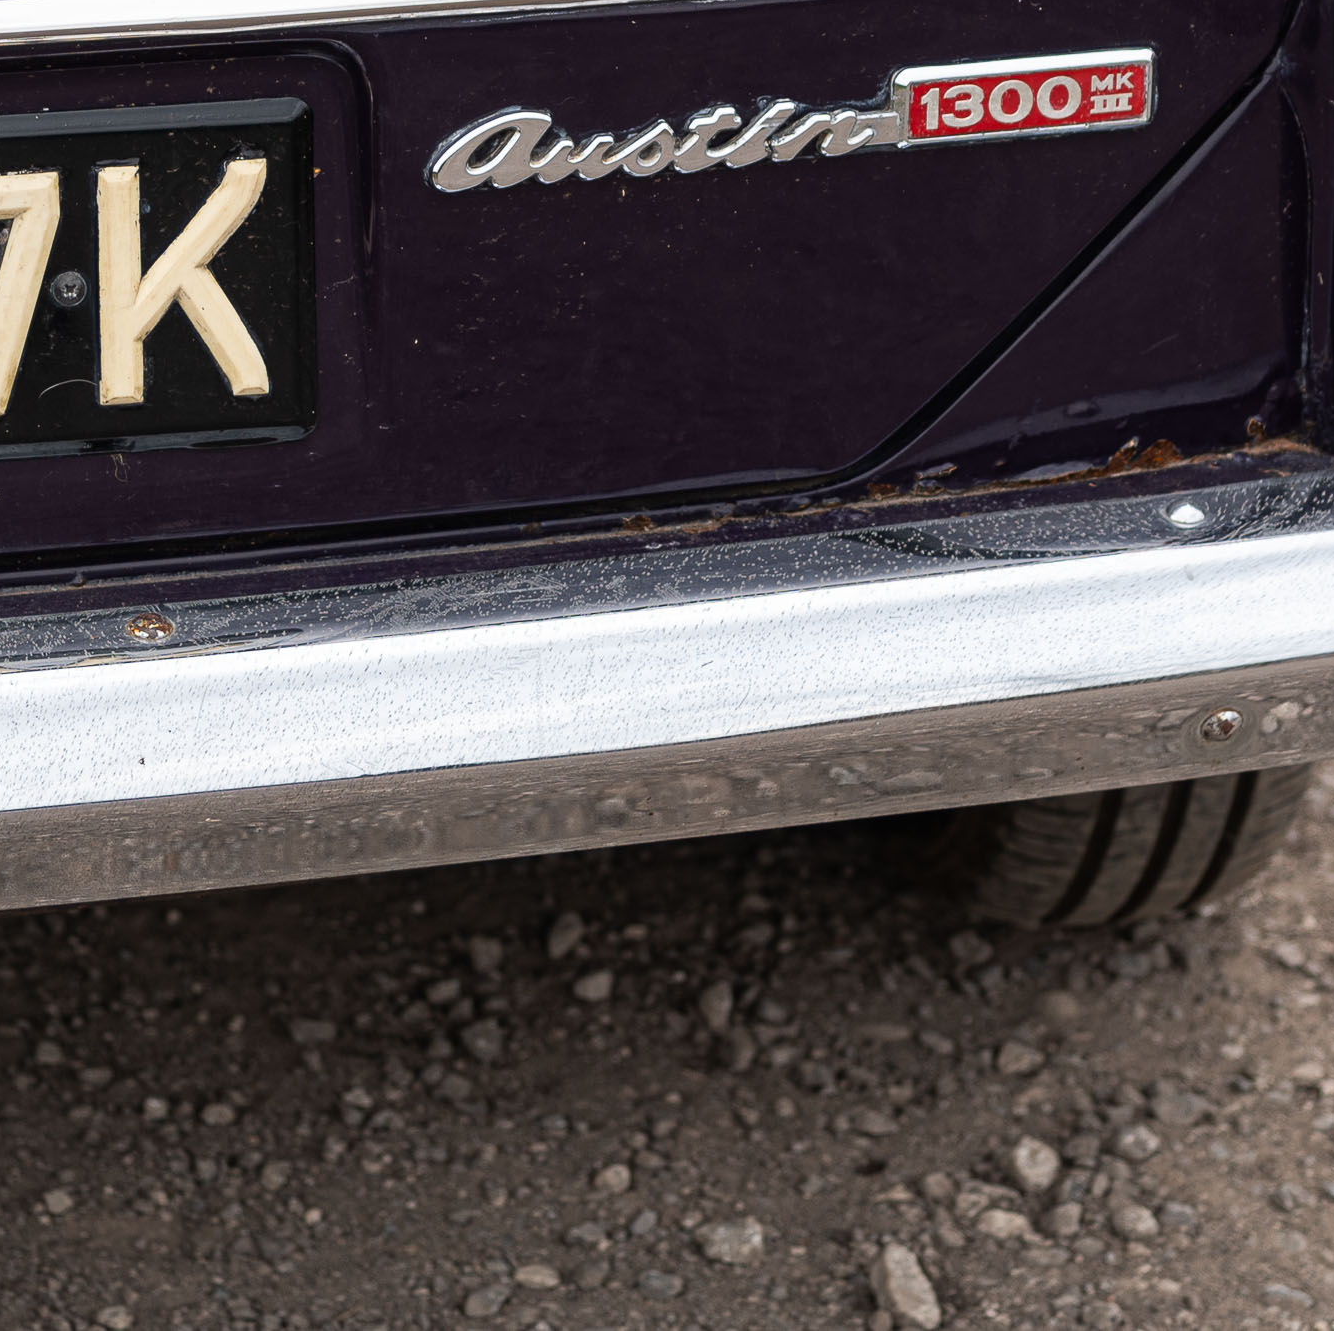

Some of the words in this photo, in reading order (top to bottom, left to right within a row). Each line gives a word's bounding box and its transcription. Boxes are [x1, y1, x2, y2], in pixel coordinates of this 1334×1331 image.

[1090, 70, 1135, 93] MK
[1089, 93, 1134, 115] III
[431, 98, 900, 193] Austin
[920, 75, 1082, 131] 1300
